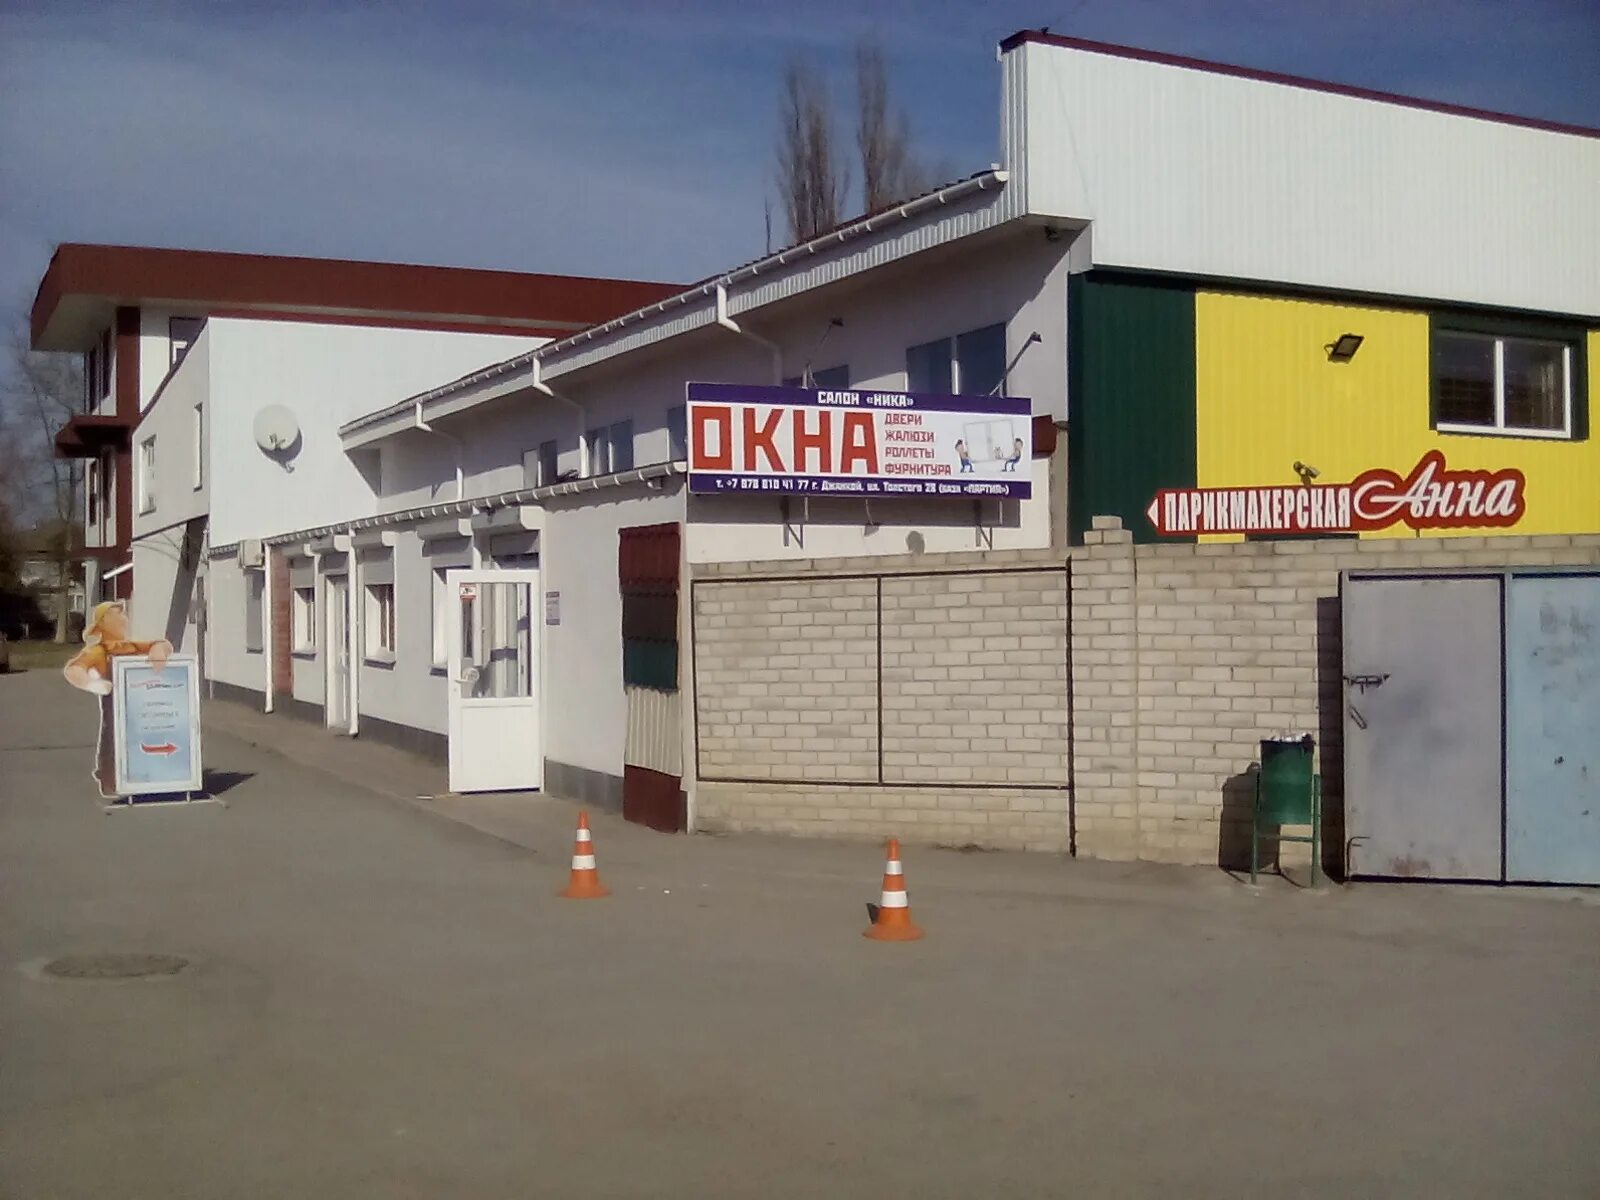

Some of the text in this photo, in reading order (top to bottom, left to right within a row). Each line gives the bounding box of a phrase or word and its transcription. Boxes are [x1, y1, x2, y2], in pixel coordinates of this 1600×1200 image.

[818, 392, 914, 407] САЛОН «НИКА»
[884, 413, 923, 426] ДВЕРИ
[692, 405, 879, 474] ОКНА
[884, 430, 935, 442] ЖАЛЮЗИ
[884, 447, 935, 459] РОЛЛЕТЫ
[884, 462, 952, 475] ФУРНИТУРА
[797, 479, 809, 490] 77
[1164, 460, 1517, 532] ПАРИКМАХЕРСКАЯ Анна
